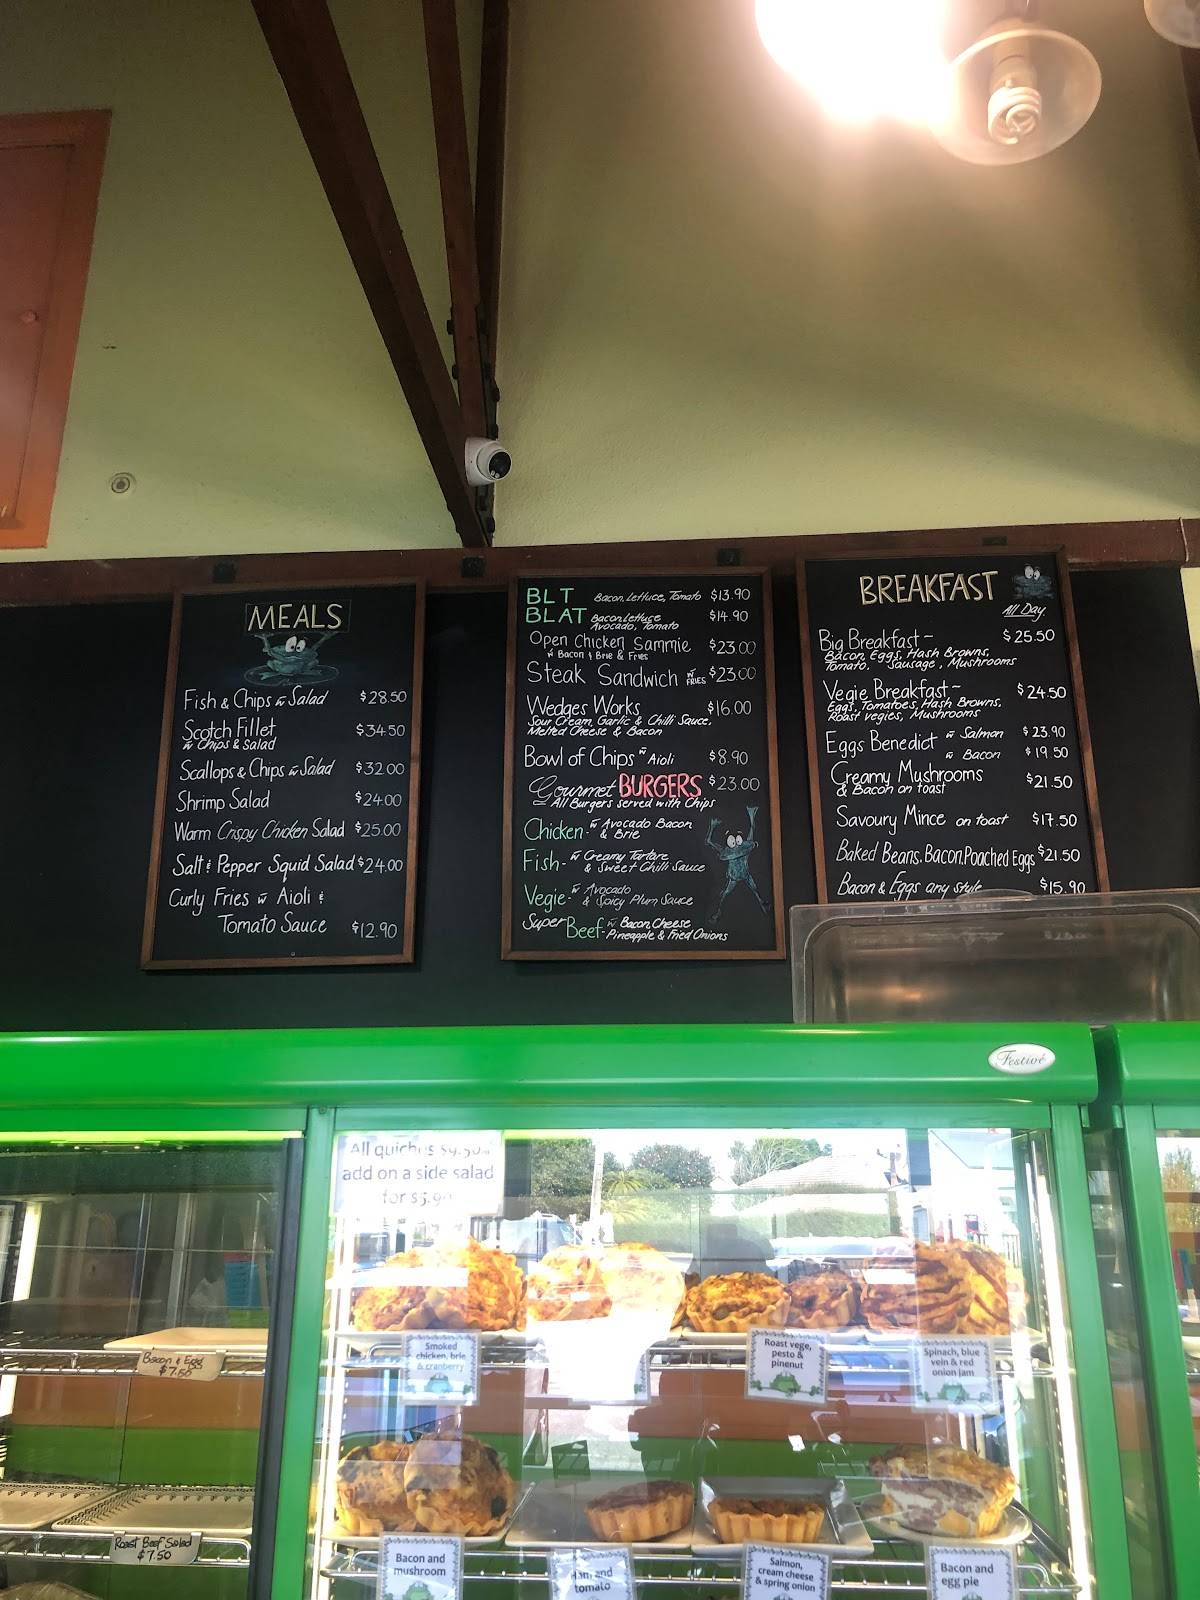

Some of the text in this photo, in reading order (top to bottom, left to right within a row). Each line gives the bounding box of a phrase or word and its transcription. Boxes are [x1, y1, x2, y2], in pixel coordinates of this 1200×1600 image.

[860, 571, 998, 605] BREAKFAST
[526, 588, 750, 604] BLT Tomato $13.90
[525, 607, 748, 624] BLAT $14.90
[1002, 604, 1018, 616] All
[248, 604, 342, 632] MEALS
[642, 621, 680, 630] Tomato
[530, 630, 756, 654] Open Chicken Sammie $23.00
[818, 628, 843, 652] Big
[1002, 628, 1055, 644] $25.50
[906, 648, 939, 659] Hash
[947, 657, 1017, 668] Mushrooms
[526, 660, 756, 688] Steak Sandwich $23.00
[823, 680, 868, 702] Vegie
[1017, 683, 1066, 700] $24.50
[184, 685, 408, 712] Fish Chips Salad $28.50
[920, 698, 952, 709] Hash
[526, 694, 752, 718] Wedges Works $16.00
[527, 714, 676, 726] Sour Garlic Chilli
[909, 709, 980, 720] Mushrooms
[182, 717, 406, 742] Scotch Fillet $34.50
[527, 726, 662, 736] Melted Cheese Bacon
[197, 738, 230, 752] Chips
[826, 726, 1066, 759] Eggs Benedict Salmon $23.90
[524, 744, 748, 769] Bowl of Chips Aioli $8.90
[962, 746, 1068, 760] Bacon $19.50
[180, 755, 405, 784] Scallops Chips Salad $32.00
[830, 760, 1072, 789] Creamy Mushrooms $21.50
[529, 773, 760, 801] Gourmet BURGERS $23.00
[852, 783, 946, 795] Bacon on toast
[175, 788, 402, 813] Shrimp Salad $24.00
[551, 798, 716, 813] All Burgers with Chips
[602, 819, 692, 829] Avocado Bacon
[836, 805, 1077, 835] Savoury Mince on toast $17.50
[174, 818, 401, 843] Warm Crispy Chicken Salad $25.00
[614, 830, 641, 839] Brie
[584, 849, 669, 863] Creamy Tartare
[836, 838, 1080, 873] Baked Poached Eggs $21.50
[172, 854, 403, 882] Salt Pepper Squid Salad $24.00
[598, 862, 706, 873] Sweet Chilli Sauce
[584, 885, 632, 895] Avocado
[836, 872, 875, 895] Bacon
[889, 871, 921, 901] Eggs
[926, 881, 949, 898] any
[1040, 878, 1086, 895] $15.90
[168, 887, 311, 916] Curly Fries Aioli
[597, 894, 694, 911] Spicy Plum Sauce
[217, 911, 397, 938] Tomato Sauce $12.90
[522, 913, 566, 930] Super
[652, 918, 691, 928] Cheese
[668, 931, 728, 941] Fried Onions
[343, 1165, 494, 1180] add on side salad
[425, 1342, 458, 1350] Smoked
[764, 1338, 812, 1351] Roast vege,
[142, 1352, 172, 1364] Bacon
[772, 1350, 795, 1359] pesto
[961, 1348, 980, 1356] blue
[931, 1358, 974, 1366] vein red
[160, 1365, 192, 1378] $7.50
[932, 1368, 956, 1376] onion
[115, 1536, 192, 1550] Roast Beef Salad
[137, 1550, 172, 1562] $7.50
[395, 1553, 445, 1564] Bacon and
[393, 1566, 446, 1576] mushroom
[758, 1567, 814, 1581] cream cheese
[941, 1562, 994, 1573] Bacon and
[764, 1578, 816, 1592] spring onion
[941, 1576, 979, 1588] egg pie
